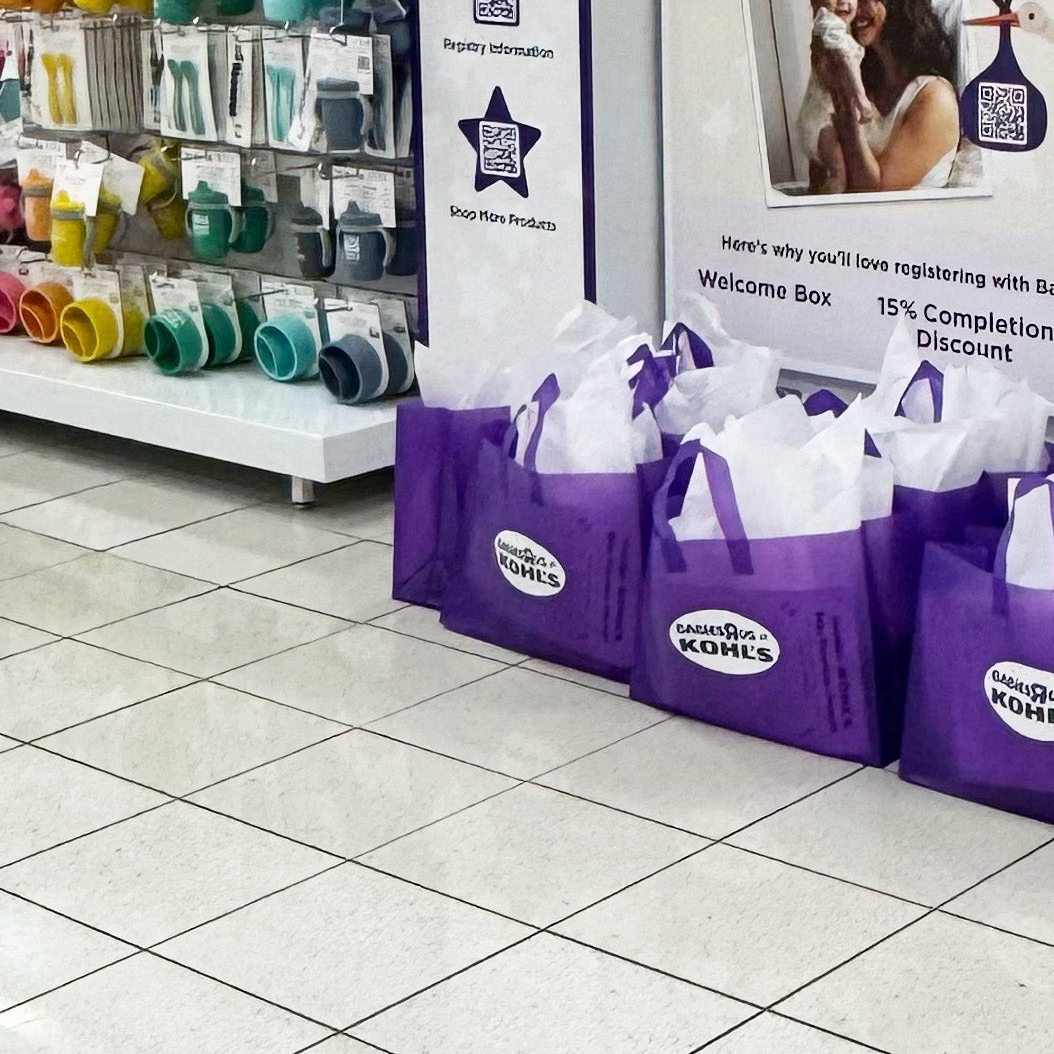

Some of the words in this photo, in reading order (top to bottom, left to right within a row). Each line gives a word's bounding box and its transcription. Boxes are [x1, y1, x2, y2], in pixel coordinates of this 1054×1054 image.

[722, 235, 768, 255] Here's
[772, 243, 804, 262] why
[809, 249, 851, 267] you'll
[856, 254, 889, 273] love
[894, 261, 986, 289] registering
[992, 273, 1029, 292] with
[698, 269, 787, 300] Welcome
[795, 284, 832, 307] Box
[877, 296, 917, 320] 15%
[923, 304, 1054, 342] Completion
[917, 329, 1013, 363] Discount
[679, 638, 774, 663] KOHL'S
